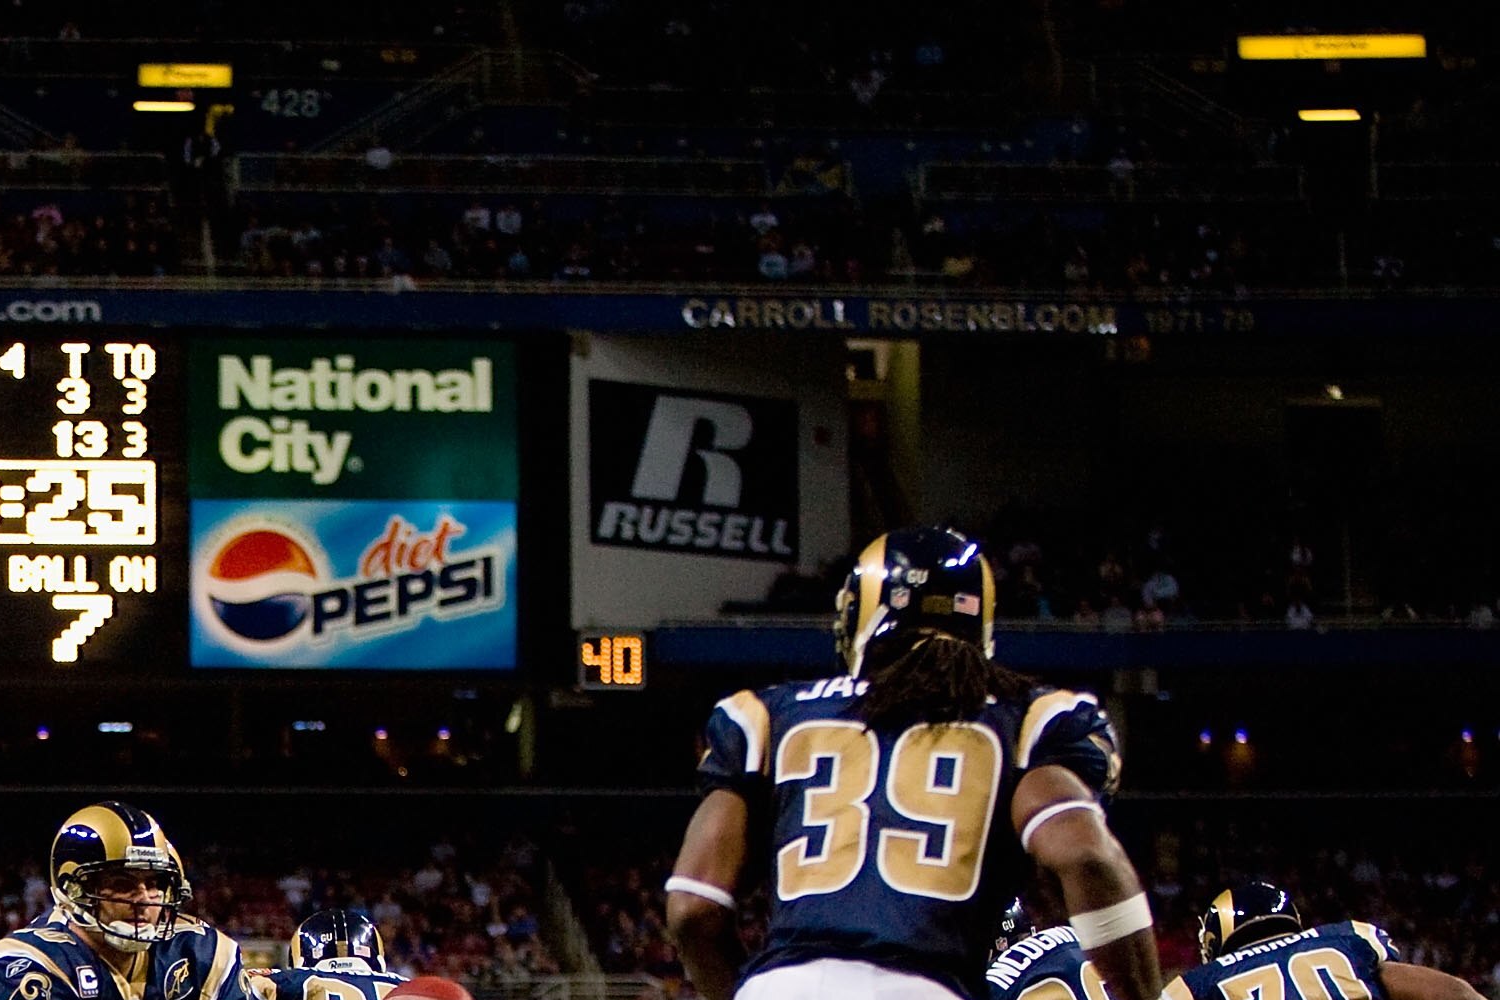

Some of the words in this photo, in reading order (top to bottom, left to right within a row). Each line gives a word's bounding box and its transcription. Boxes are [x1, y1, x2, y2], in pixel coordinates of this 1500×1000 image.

[260, 88, 321, 118] 428
[681, 299, 854, 330] CARROLL
[867, 301, 1118, 334] ROSENBLOOM
[0, 341, 25, 379] 4
[61, 341, 90, 379] T
[105, 341, 156, 379] TO
[57, 376, 90, 414] 3
[122, 376, 147, 414] 3
[217, 354, 493, 413] National
[53, 420, 108, 457] 13
[122, 420, 147, 457] 3
[596, 500, 793, 556] RUSSELL
[361, 519, 467, 578] diet
[8, 554, 99, 593] BALL
[109, 555, 157, 593] ON
[311, 554, 494, 637] PEPSI
[52, 594, 113, 663] 7
[580, 635, 644, 685] 40
[776, 718, 1002, 903] 39
[1001, 918, 1016, 932] GU
[79, 970, 99, 991] C
